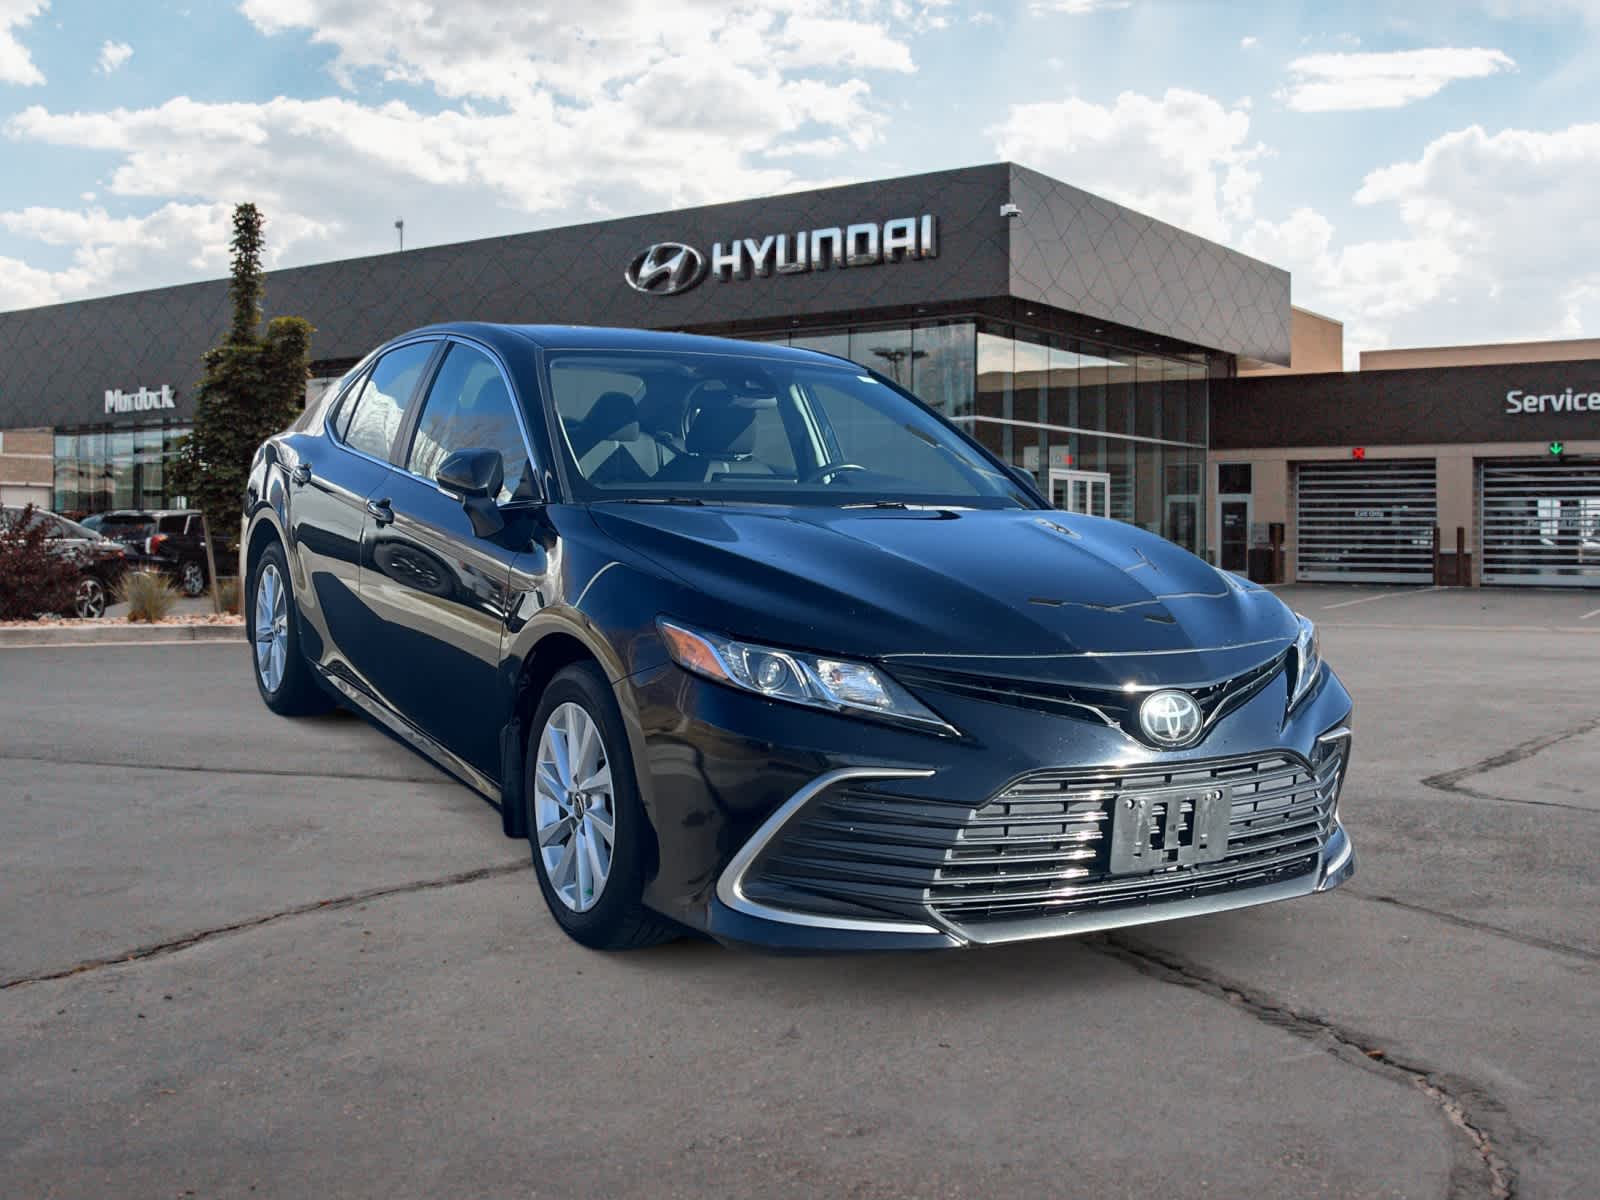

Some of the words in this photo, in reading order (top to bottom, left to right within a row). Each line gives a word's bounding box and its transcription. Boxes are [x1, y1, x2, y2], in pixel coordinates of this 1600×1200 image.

[711, 214, 937, 281] HYUNDAI
[104, 384, 176, 414] Murdock
[1505, 387, 1600, 413] Service
